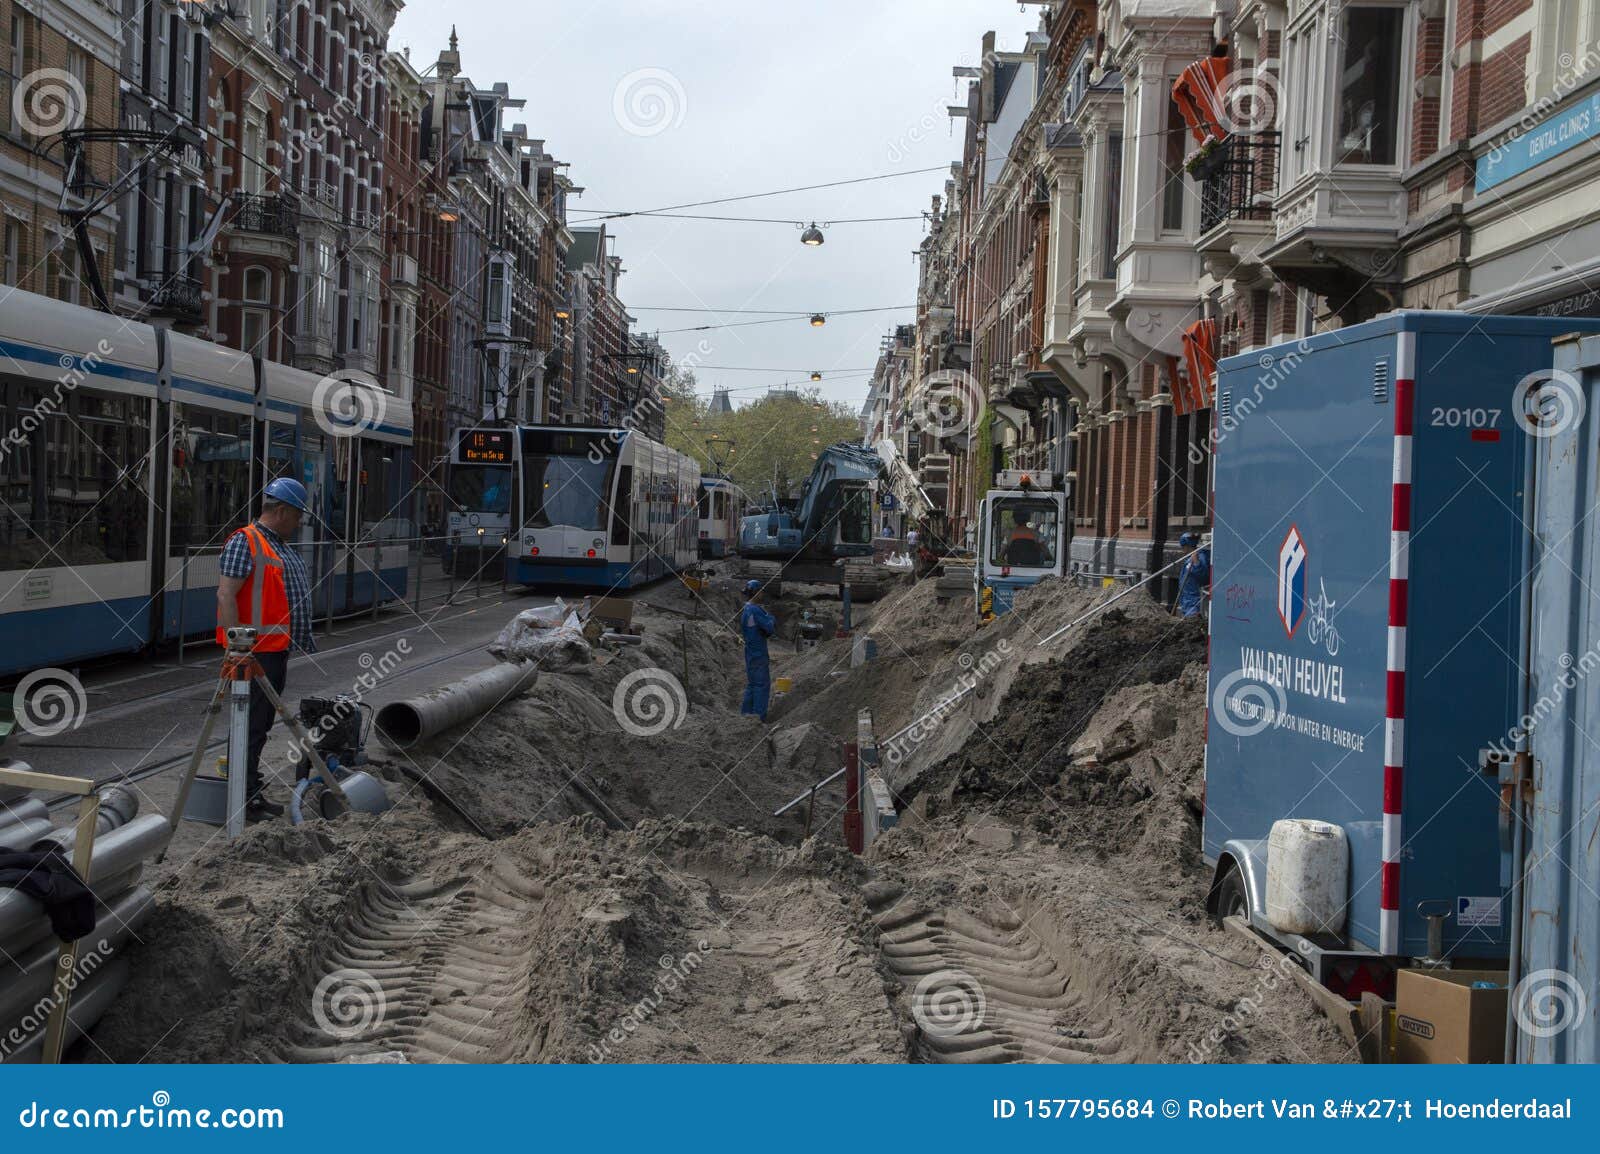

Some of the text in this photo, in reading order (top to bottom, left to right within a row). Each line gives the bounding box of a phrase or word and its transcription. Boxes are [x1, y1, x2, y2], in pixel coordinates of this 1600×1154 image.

[1529, 128, 1557, 157] DENTAL
[1558, 109, 1591, 144] CLINICS
[1431, 407, 1502, 428] 20107
[1241, 646, 1347, 704] VAN DEN HEUVEL
[1276, 711, 1296, 731] VOOR
[1298, 716, 1320, 739] WATER
[1322, 724, 1331, 743] EN
[1333, 727, 1364, 753] ENERGIE
